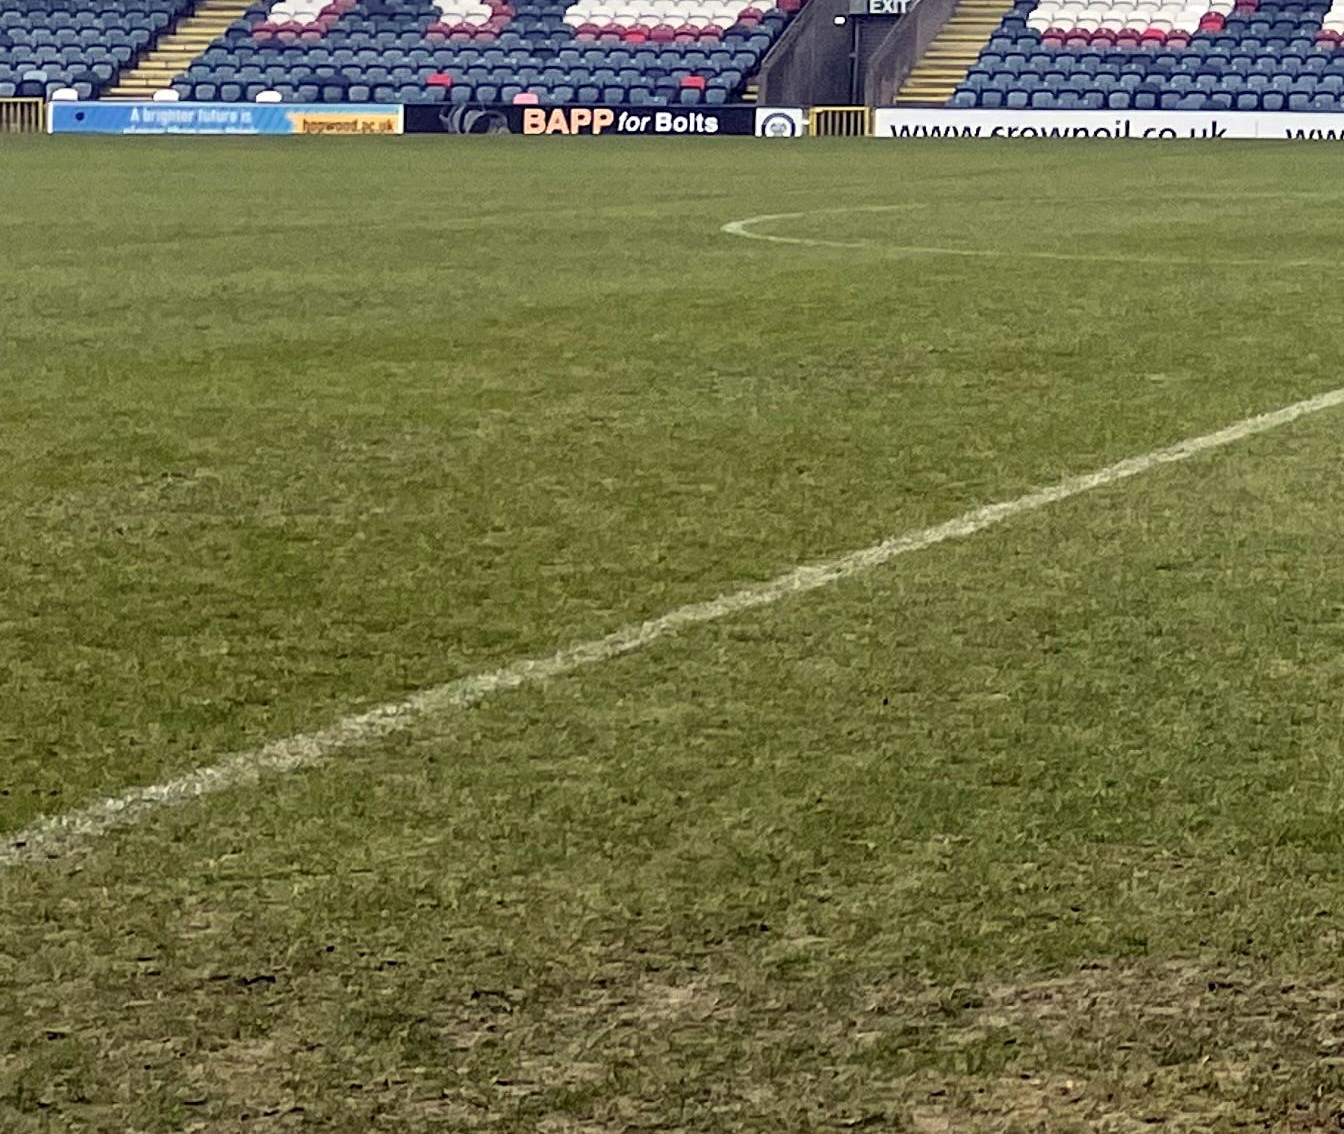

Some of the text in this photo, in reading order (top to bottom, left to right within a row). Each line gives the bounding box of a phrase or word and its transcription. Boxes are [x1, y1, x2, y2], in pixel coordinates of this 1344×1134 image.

[523, 108, 720, 135] BAPP for Bolts
